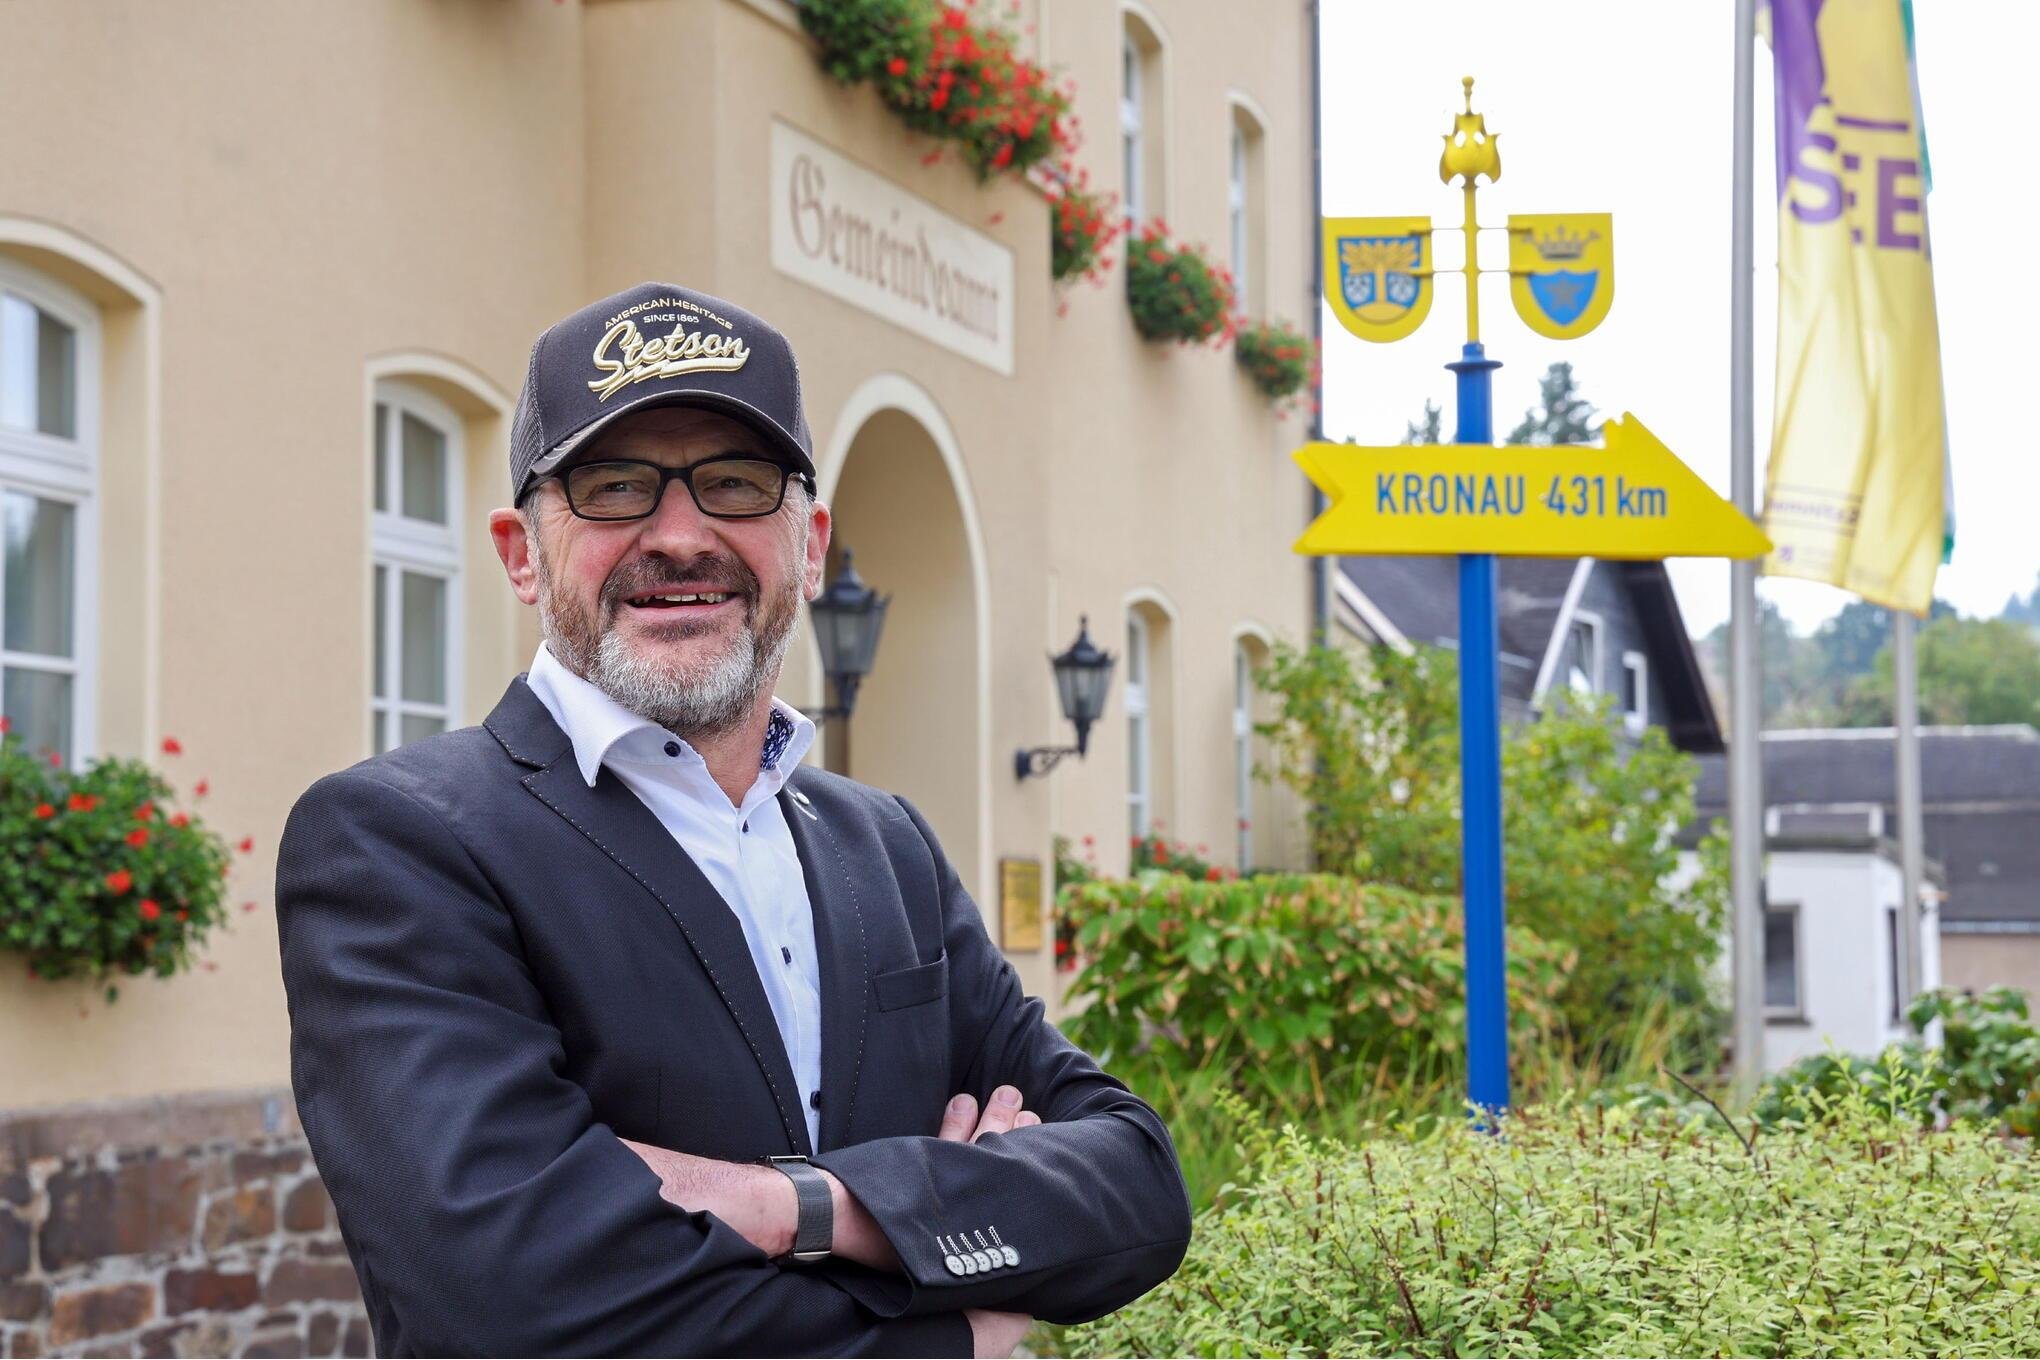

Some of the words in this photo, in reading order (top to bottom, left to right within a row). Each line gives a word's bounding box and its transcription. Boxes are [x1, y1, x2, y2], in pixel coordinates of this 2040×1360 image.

[789, 152, 998, 343] Gemeindeamt
[605, 298, 670, 331] AMERICAN
[672, 298, 734, 331] HERITAGE
[643, 313, 676, 324] SINCE
[676, 313, 700, 324] 1865
[587, 319, 751, 395] Stetson
[1376, 472, 1526, 516] KRONAU
[1546, 474, 1606, 517] 431
[1616, 474, 1668, 518] km
